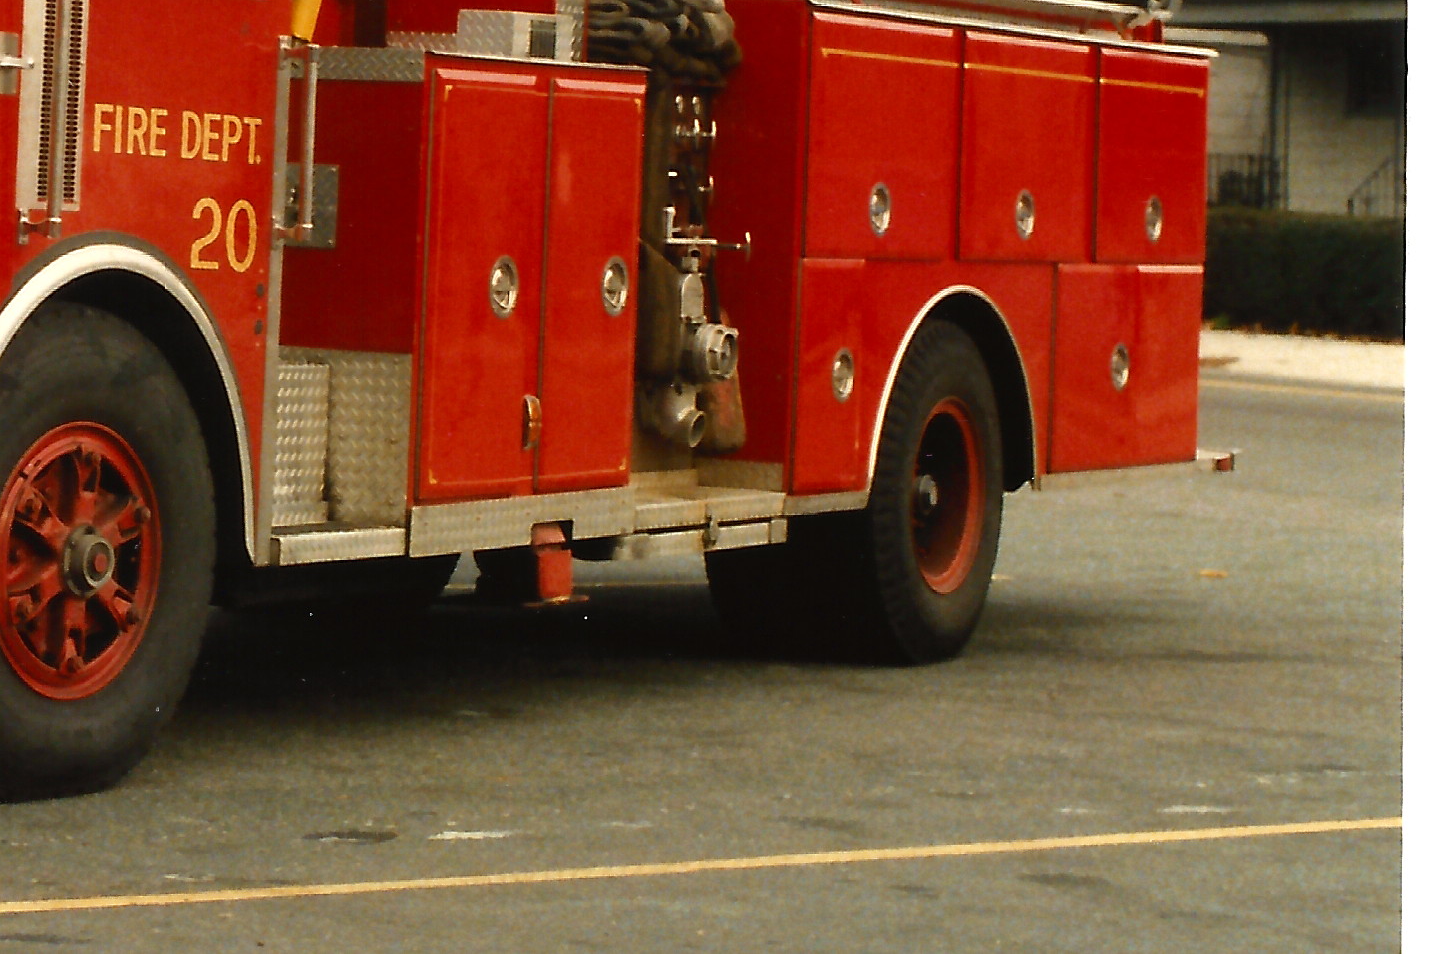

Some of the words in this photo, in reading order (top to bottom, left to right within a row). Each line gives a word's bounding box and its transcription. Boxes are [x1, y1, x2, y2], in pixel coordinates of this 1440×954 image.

[92, 103, 168, 157] FIRE
[180, 110, 264, 165] DEPT.
[189, 197, 258, 273] 20
